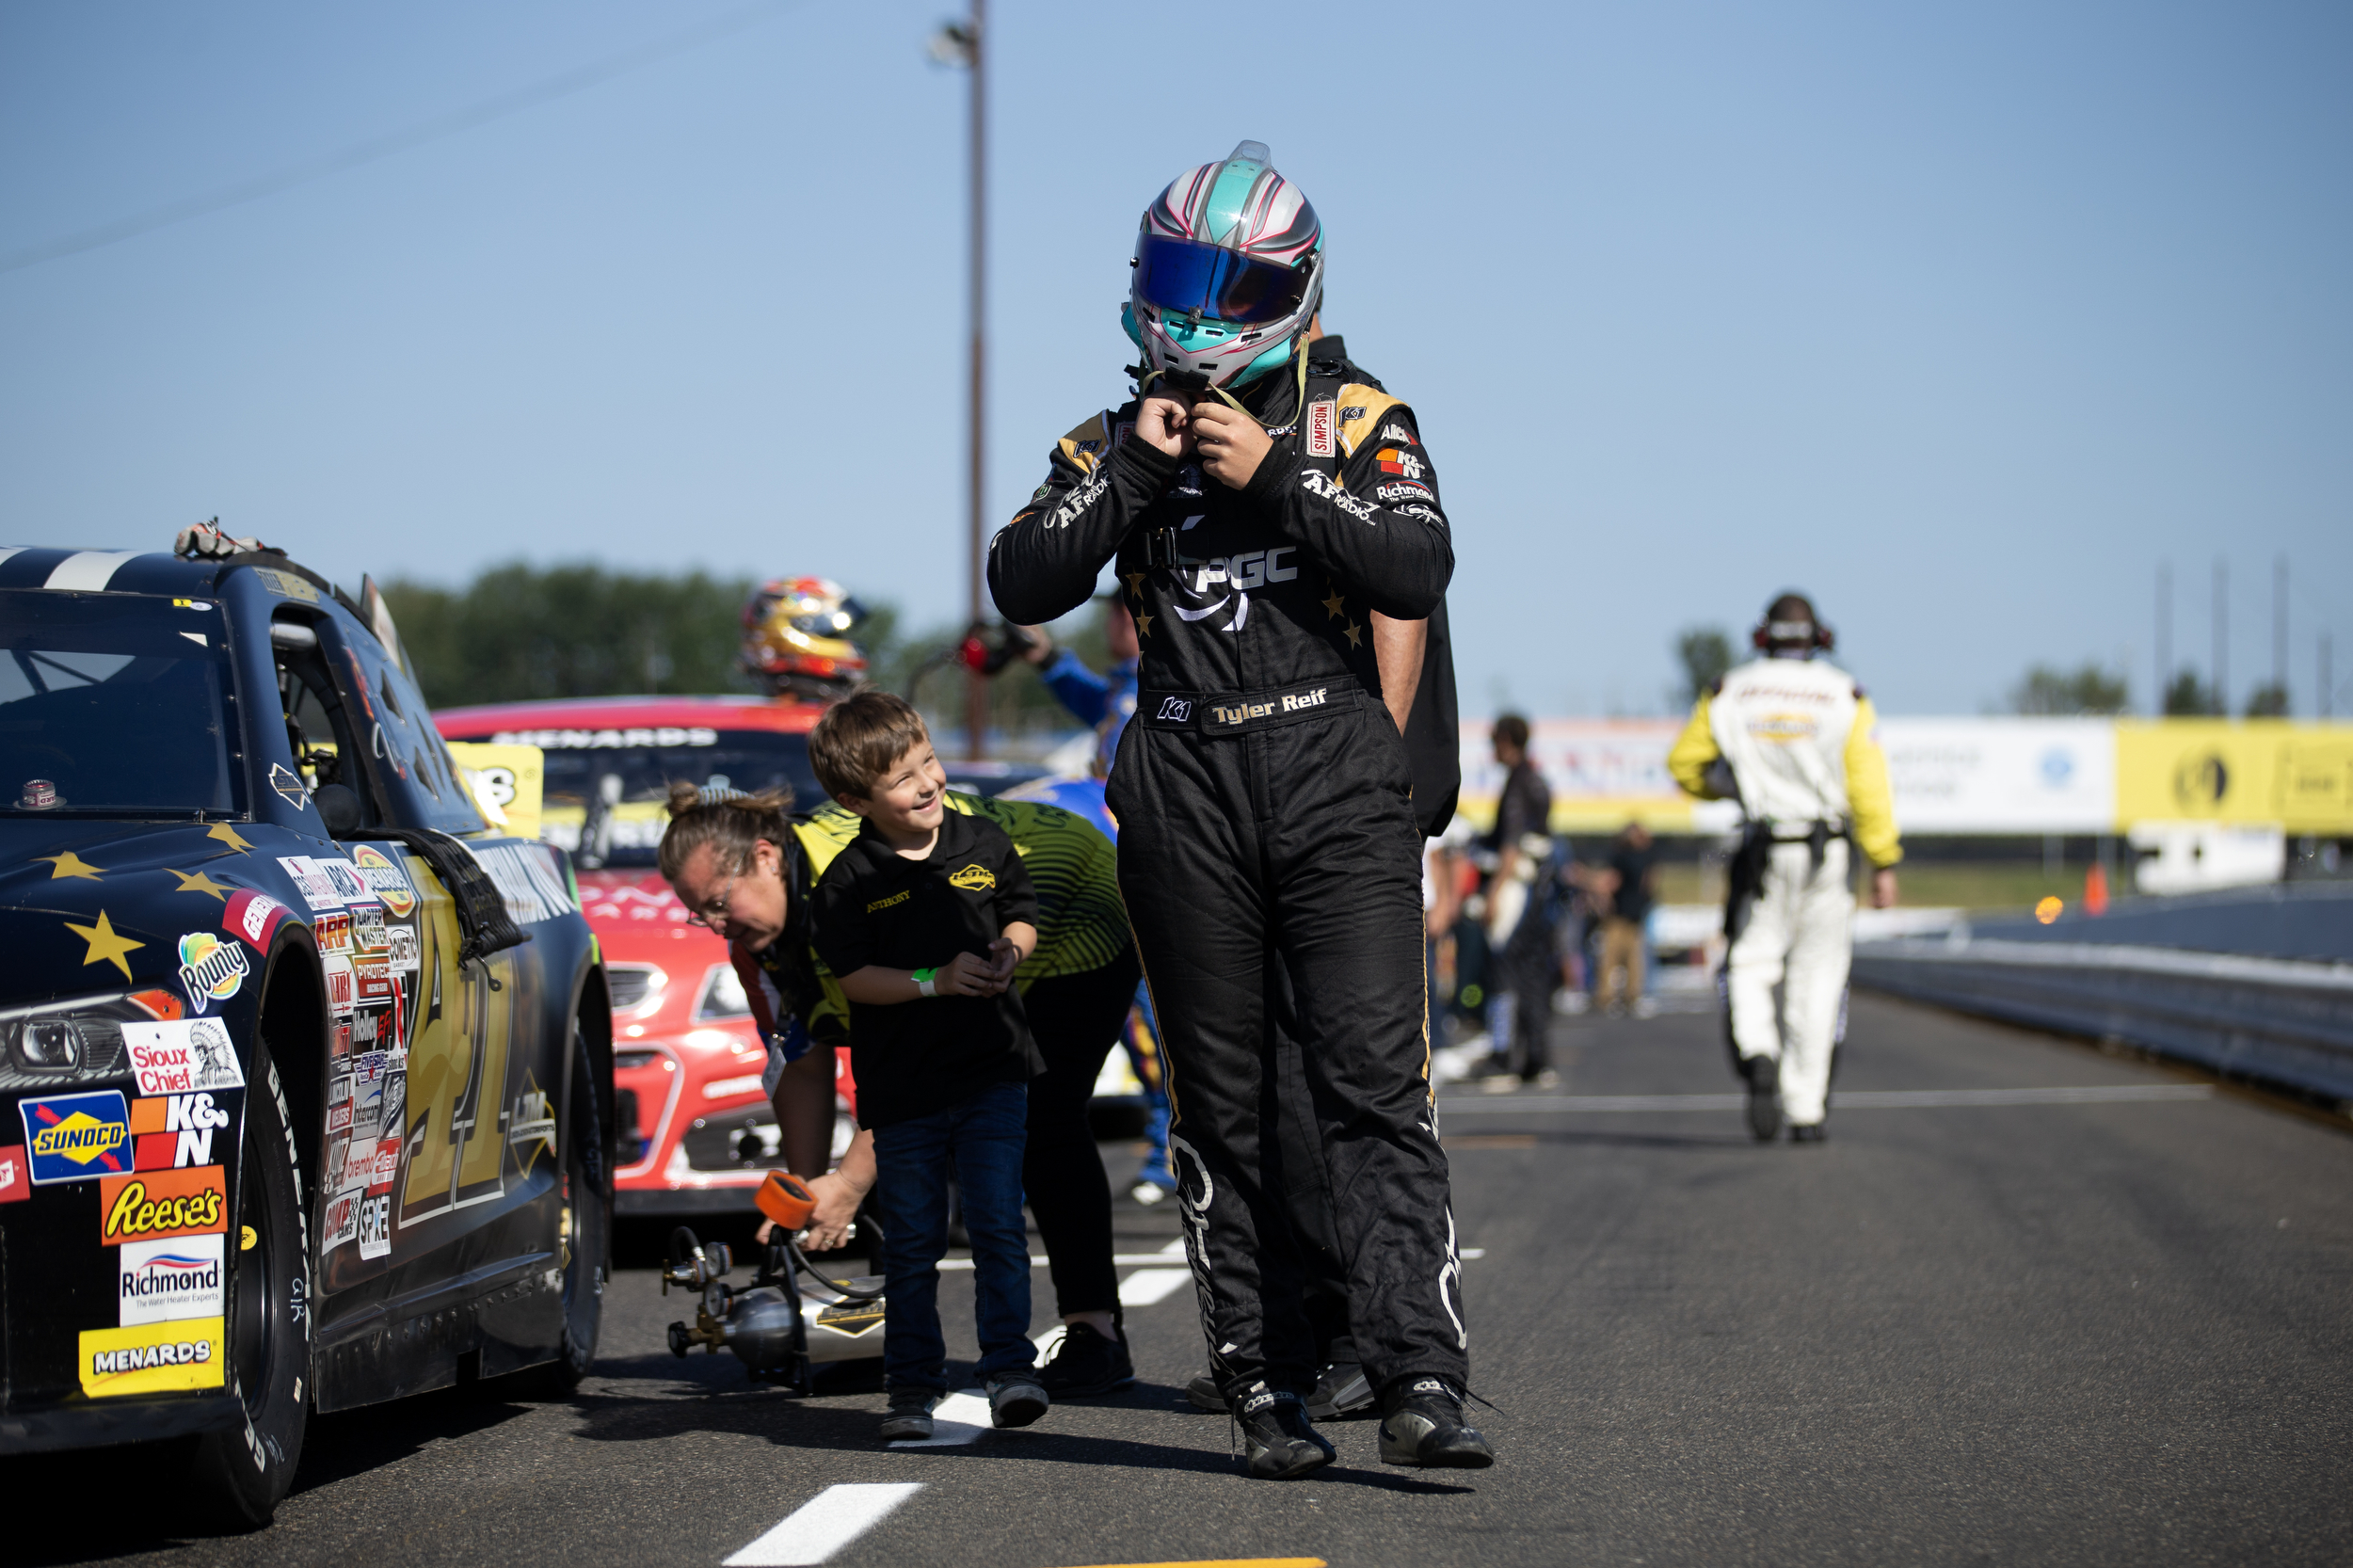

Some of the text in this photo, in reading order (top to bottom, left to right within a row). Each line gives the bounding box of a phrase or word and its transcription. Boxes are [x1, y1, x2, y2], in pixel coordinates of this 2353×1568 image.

[1314, 406, 1328, 451] SIMPSON
[1156, 696, 1193, 722] K1
[1211, 688, 1327, 726] Tyler Reif
[323, 864, 364, 898] ARCA
[357, 866, 410, 894] MENARDS
[866, 889, 910, 914] ANTHONY
[315, 915, 351, 952] ARP
[354, 907, 384, 935] QUARTER
[360, 924, 390, 950] MASTER
[389, 936, 417, 962] COMETIC
[178, 939, 250, 1014] Bounty
[354, 1009, 377, 1051] Holley
[133, 1045, 192, 1069] Sioux
[139, 1067, 192, 1093] Chief
[329, 1080, 350, 1107] LINCOLN
[166, 1093, 230, 1132] K&
[38, 1125, 122, 1151] SUNOCO
[174, 1128, 214, 1169] N
[347, 1152, 374, 1179] brembo
[104, 1179, 224, 1240] Reese's
[324, 1197, 351, 1242] COMP
[337, 1221, 354, 1240] CAMS
[121, 1258, 218, 1299] Richmond
[136, 1292, 219, 1309] The Water Heater Experts
[92, 1339, 212, 1376] MENARDS
